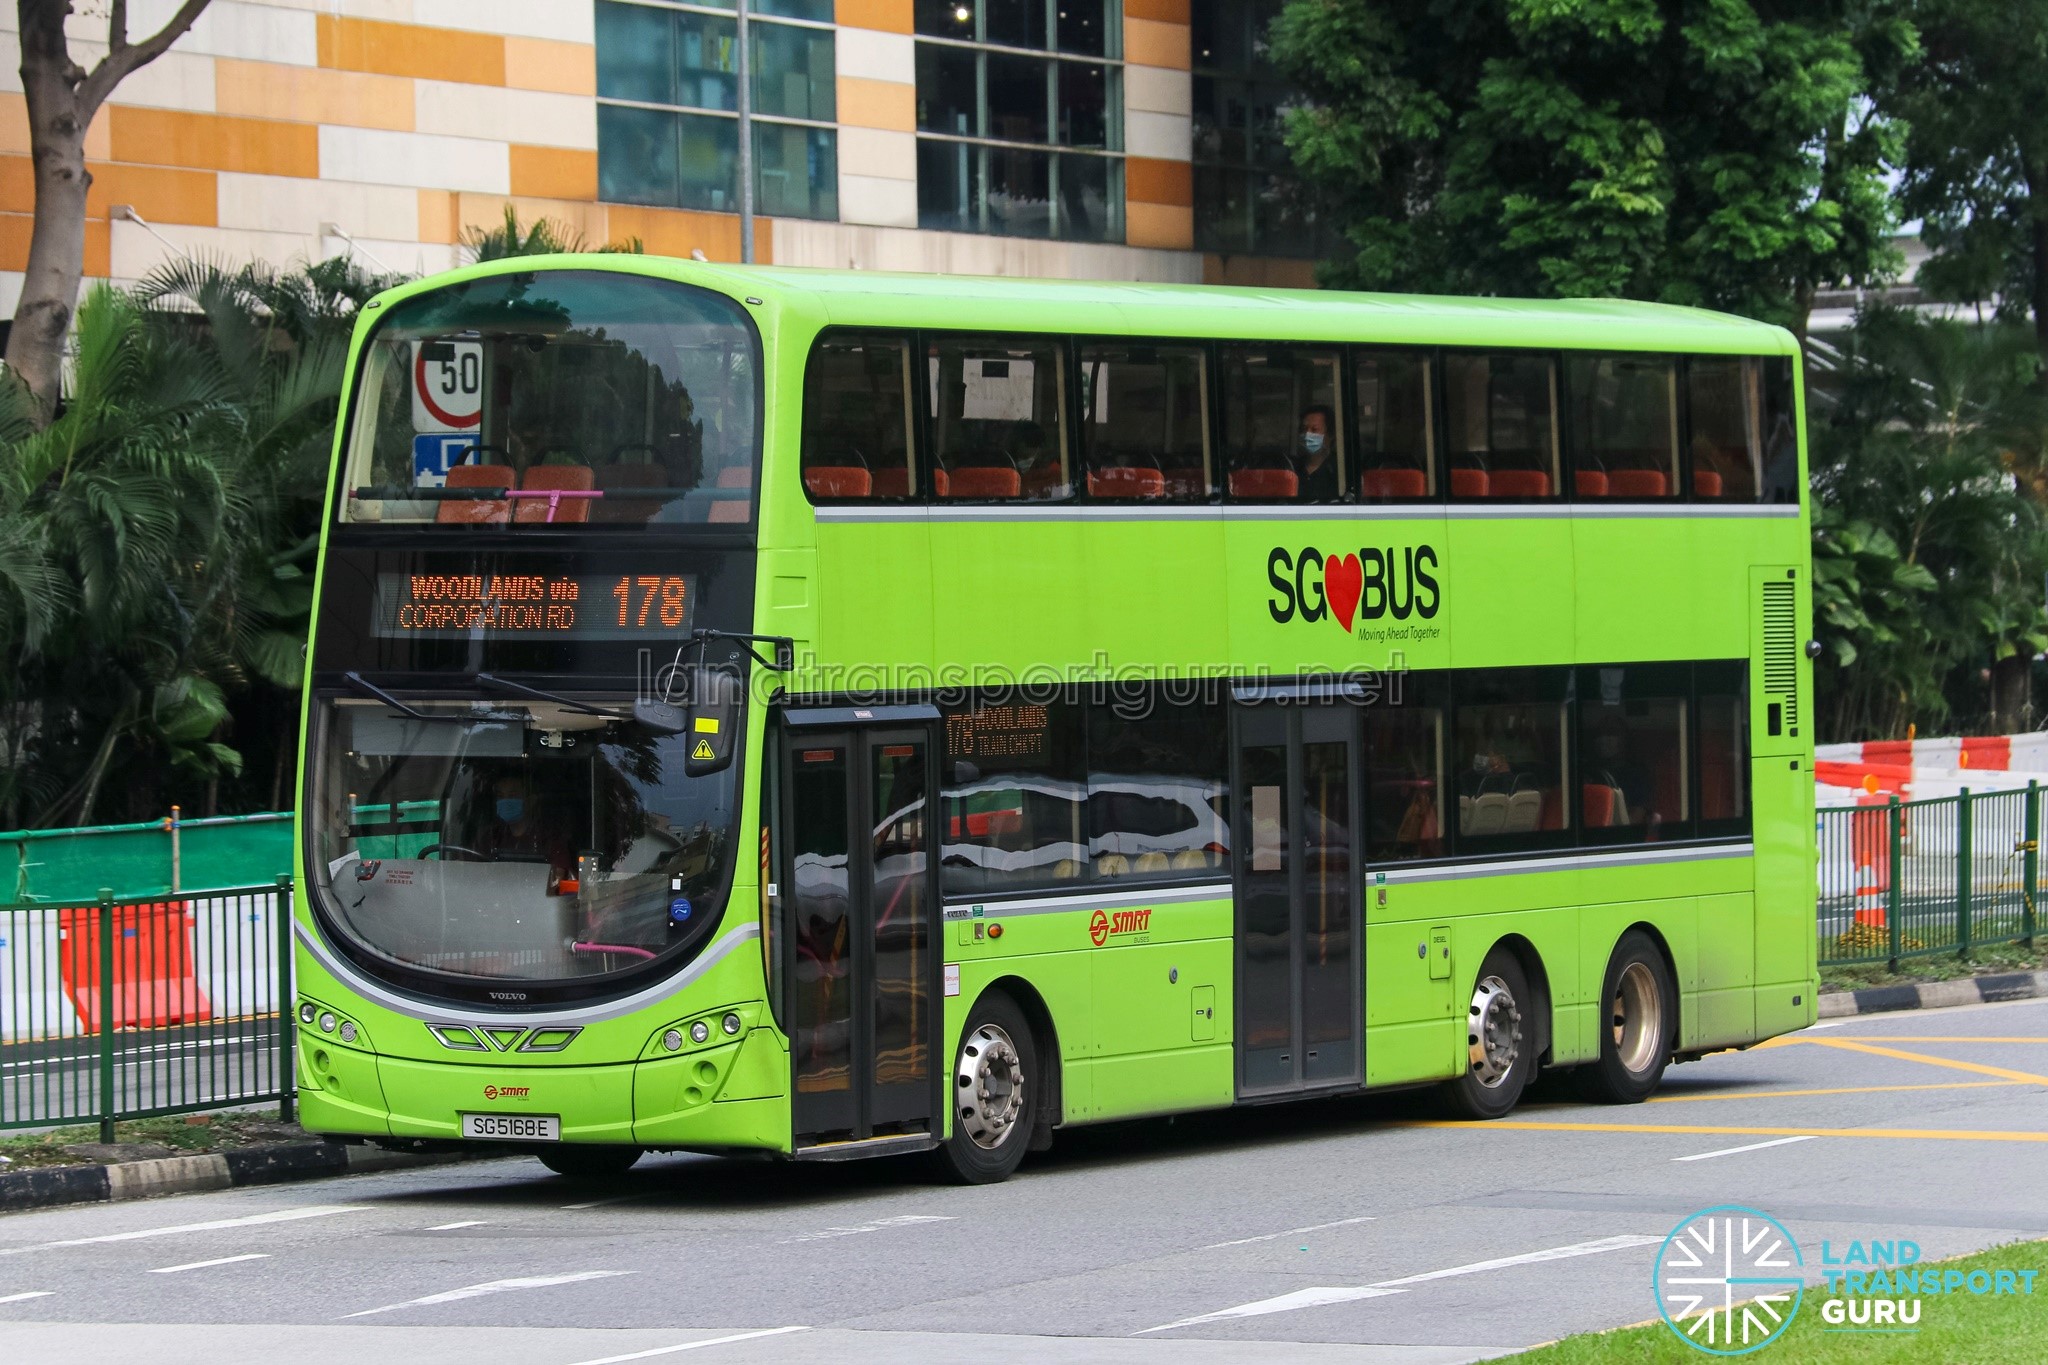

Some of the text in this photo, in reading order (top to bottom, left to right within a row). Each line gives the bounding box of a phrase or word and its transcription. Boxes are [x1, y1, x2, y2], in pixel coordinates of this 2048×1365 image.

[441, 352, 479, 394] 50
[411, 576, 579, 600] WOODLANDS via
[1359, 544, 1440, 620] BUS
[613, 577, 685, 627] 178
[400, 604, 575, 629] CORPORATION RD
[1358, 625, 1440, 644] Moving Ahead Together
[975, 704, 1047, 731] WOODLANDS
[946, 713, 973, 755] 178
[978, 735, 1007, 756] TRAIN
[1109, 909, 1152, 934] SMRT
[1133, 936, 1150, 944] BUSES
[489, 992, 527, 1000] VOLVO
[499, 1087, 530, 1097] SMRT
[474, 1118, 548, 1137] SG5168E
